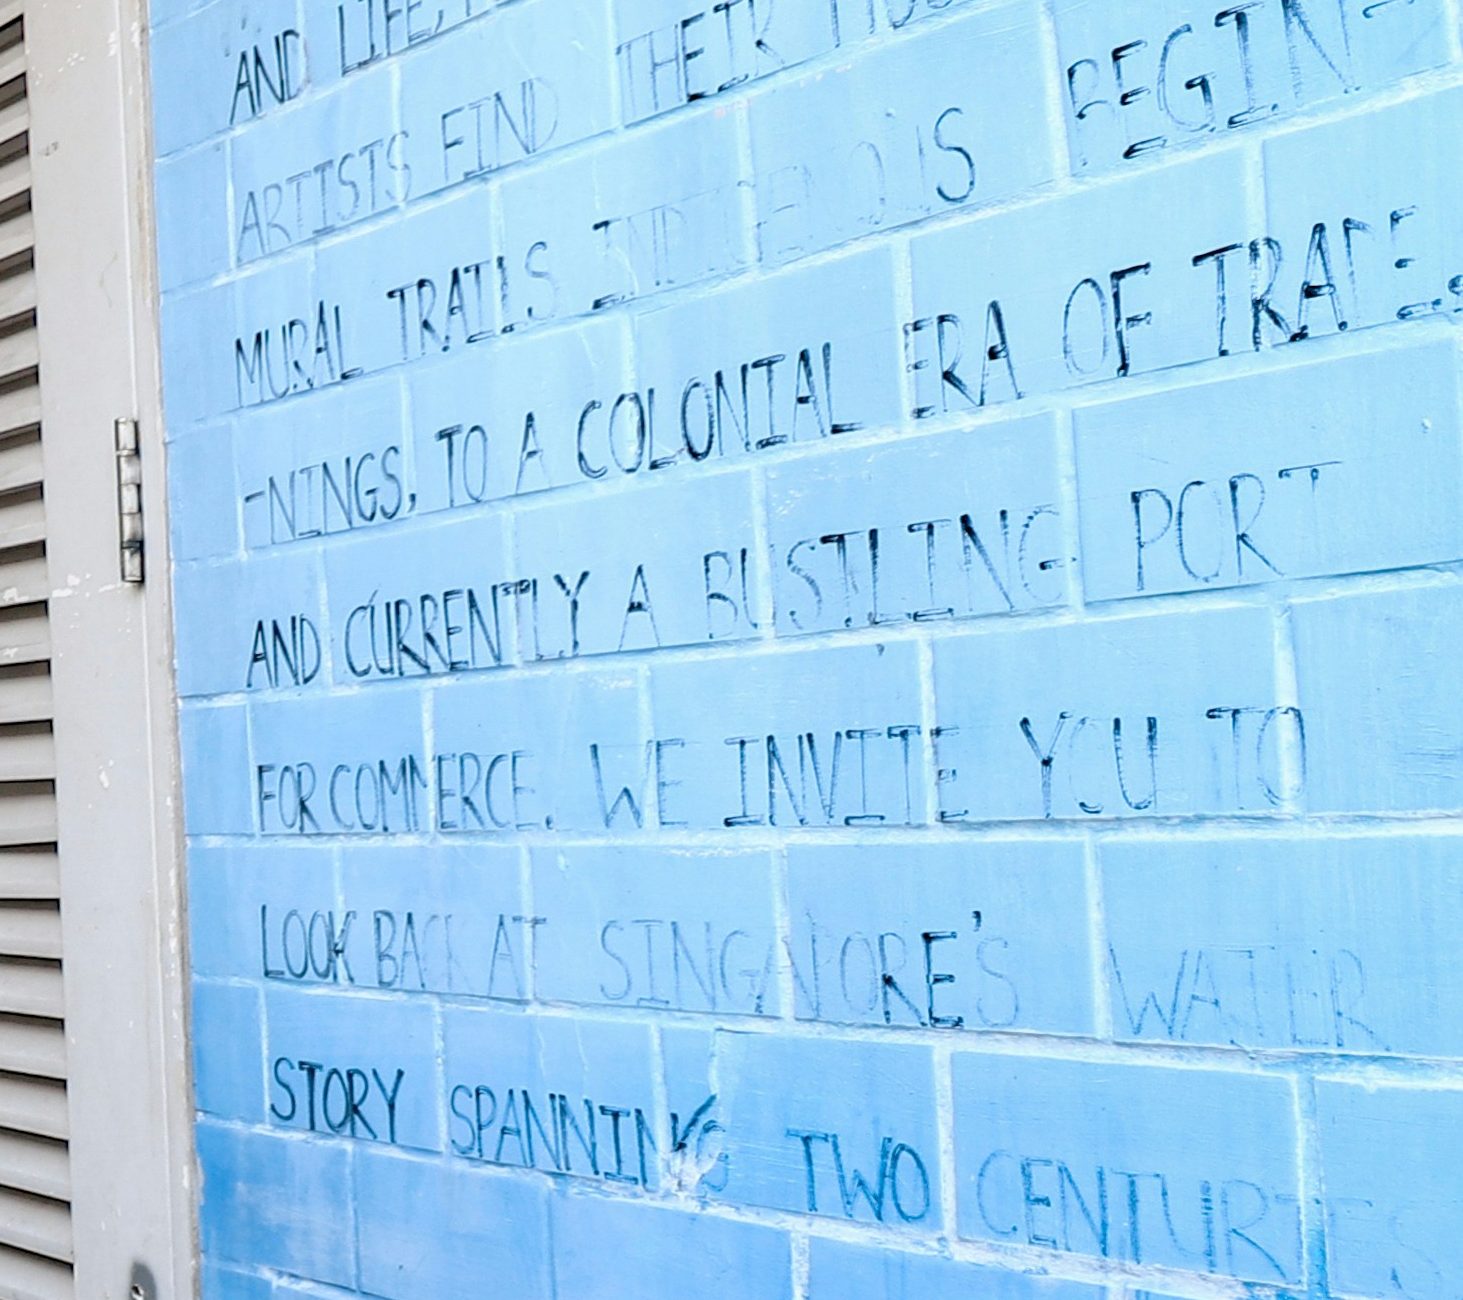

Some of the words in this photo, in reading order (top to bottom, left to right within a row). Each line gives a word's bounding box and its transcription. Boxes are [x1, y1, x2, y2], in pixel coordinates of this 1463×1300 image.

[228, 29, 310, 126] AND
[236, 130, 412, 265] ARTISTS
[440, 77, 561, 183] FIND
[234, 300, 365, 410] MURAL
[387, 241, 561, 362] TRAILS
[435, 424, 490, 509] TO
[514, 411, 553, 496] A
[576, 341, 863, 480] COLONIAL
[903, 300, 1026, 420] ERA
[1063, 262, 1152, 379] OF
[246, 615, 321, 688] AND
[344, 565, 591, 678] CURRENTLY
[618, 564, 662, 652] A
[703, 503, 1078, 640] BUSTLING
[1130, 460, 1343, 592] PORT
[257, 761, 317, 833] FOR
[589, 738, 689, 831] WE
[723, 725, 969, 828] INVITE
[1020, 711, 1159, 818] YOU
[1206, 706, 1309, 811] TO
[260, 904, 357, 981] LOOK
[491, 913, 548, 1004] AT
[269, 1057, 405, 1144] STORY
[450, 1084, 730, 1193] SPANNING
[785, 1129, 930, 1223] TWO
